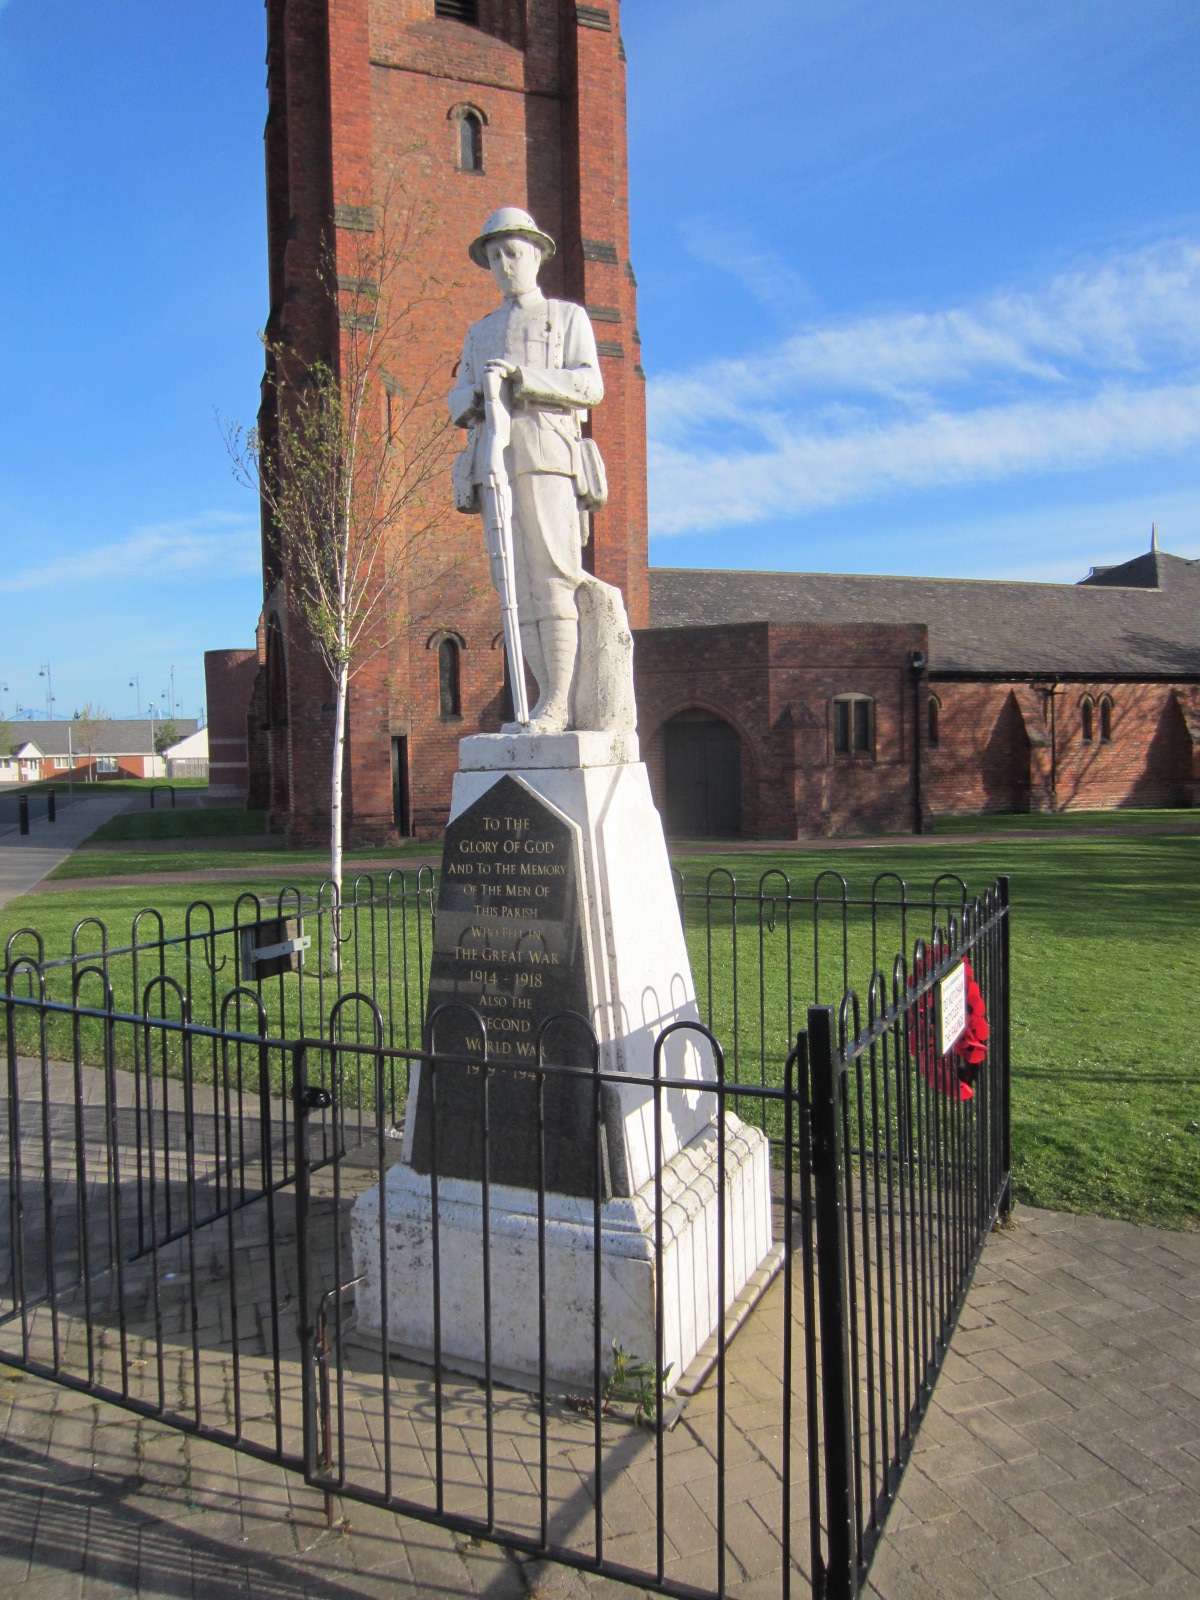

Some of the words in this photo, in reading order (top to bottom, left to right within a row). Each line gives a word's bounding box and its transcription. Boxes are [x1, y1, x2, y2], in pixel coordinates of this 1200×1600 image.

[483, 818, 500, 830] TO
[504, 817, 530, 830] THE
[460, 840, 498, 853] GLORY
[504, 840, 520, 853] OF
[524, 840, 554, 853] GOD
[448, 863, 472, 874] AND
[476, 863, 490, 874] TO
[495, 863, 516, 874] THE
[520, 864, 566, 875] MEMORY
[464, 884, 477, 895] OF
[481, 884, 502, 896] THE
[506, 885, 530, 896] MEN
[535, 885, 550, 897] OF
[474, 905, 497, 917] THIS
[502, 906, 538, 918] PARISH
[471, 926, 498, 938] WHO
[502, 928, 523, 938] FELL
[528, 929, 540, 940] IN
[454, 947, 477, 960] THE
[482, 948, 523, 961] GREAT
[529, 950, 559, 964] WAR
[470, 970, 498, 985] 1914
[515, 973, 542, 988] 1918
[478, 995, 506, 1007] ALSO
[511, 996, 532, 1009] THE
[480, 1016, 530, 1032] SECOND
[467, 1065, 496, 1076] 199
